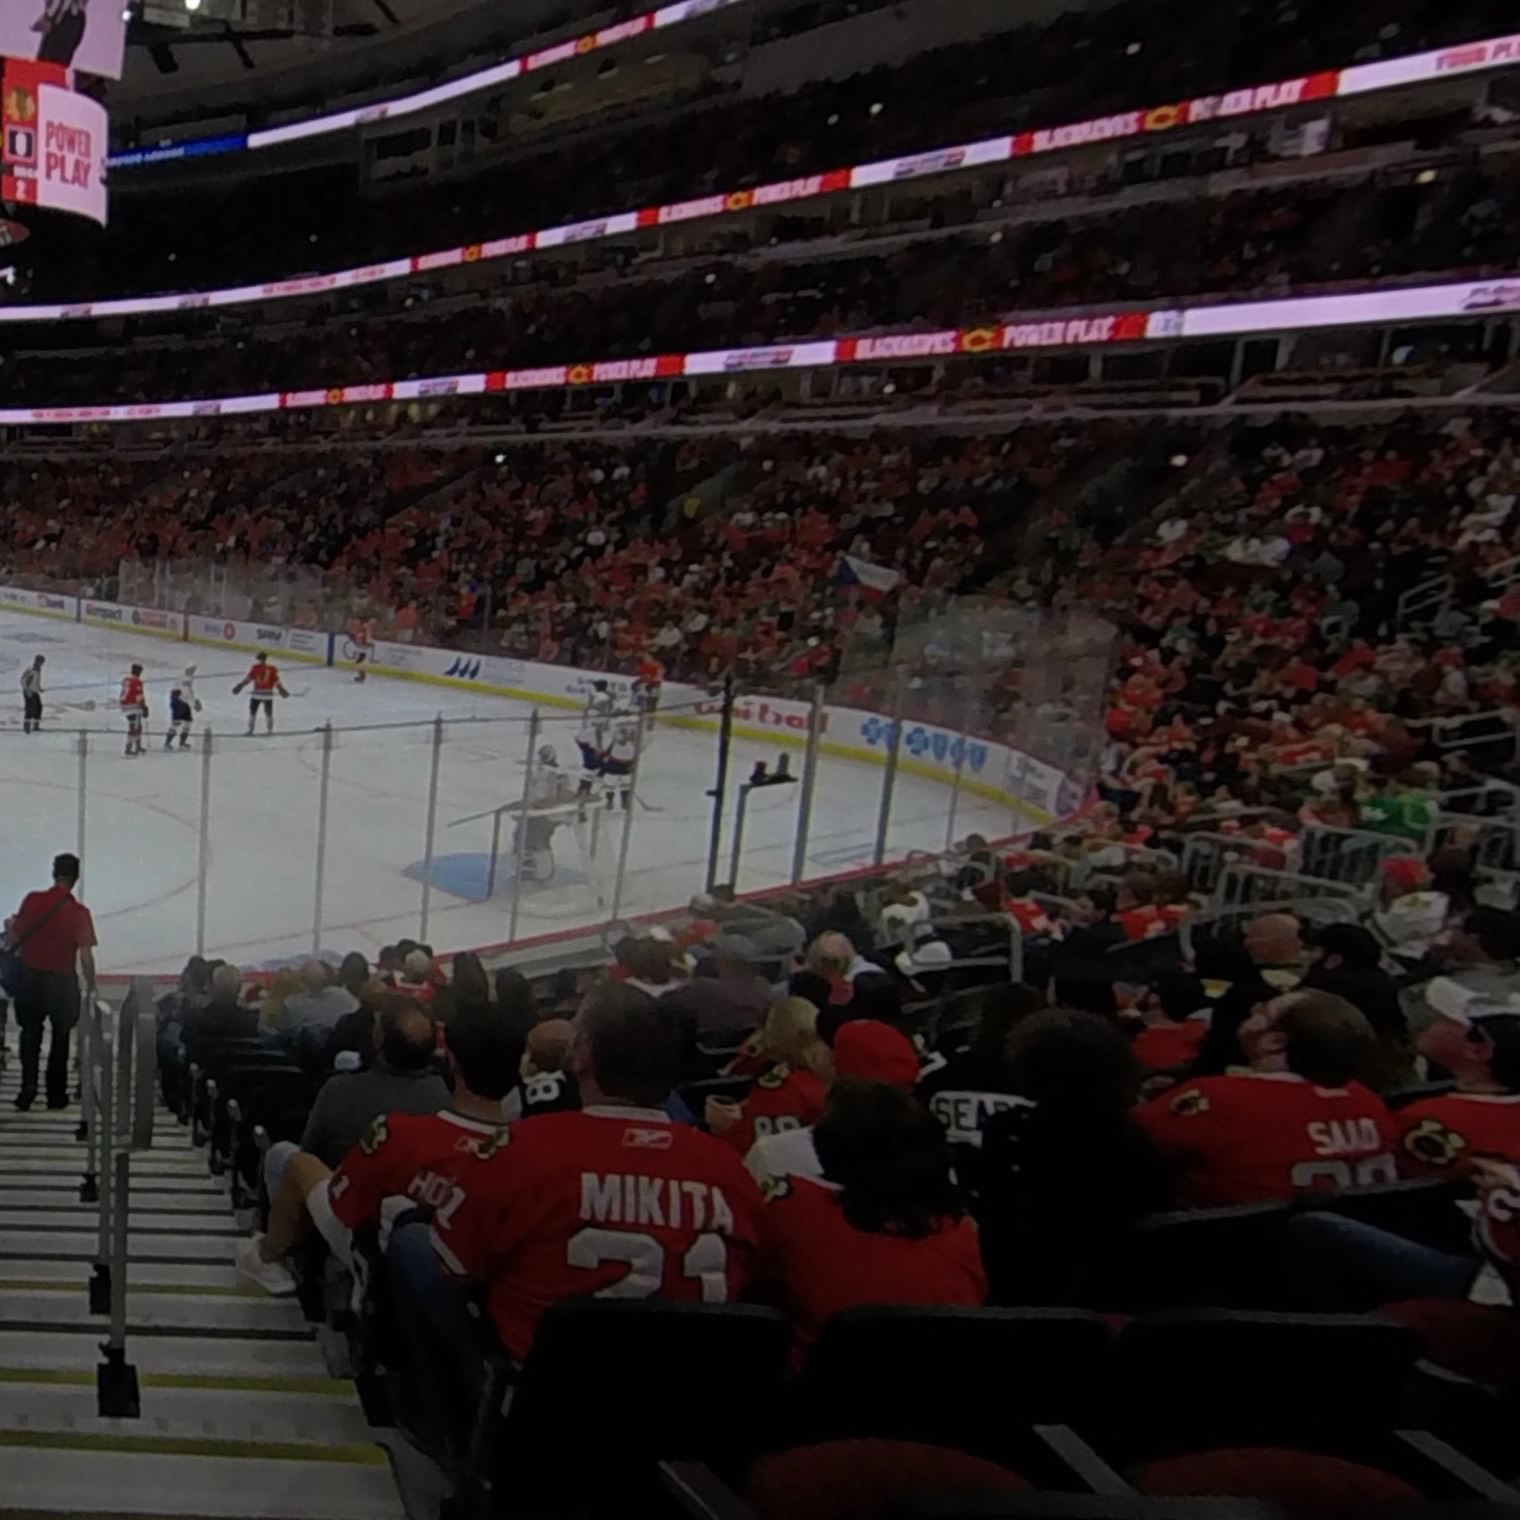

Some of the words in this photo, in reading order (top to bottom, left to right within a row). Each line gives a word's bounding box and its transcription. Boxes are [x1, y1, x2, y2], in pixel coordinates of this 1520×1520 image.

[45, 120, 92, 159] POWER
[46, 153, 92, 189] PLAY
[579, 1170, 736, 1237] MIKITA
[565, 1225, 728, 1305] 21
